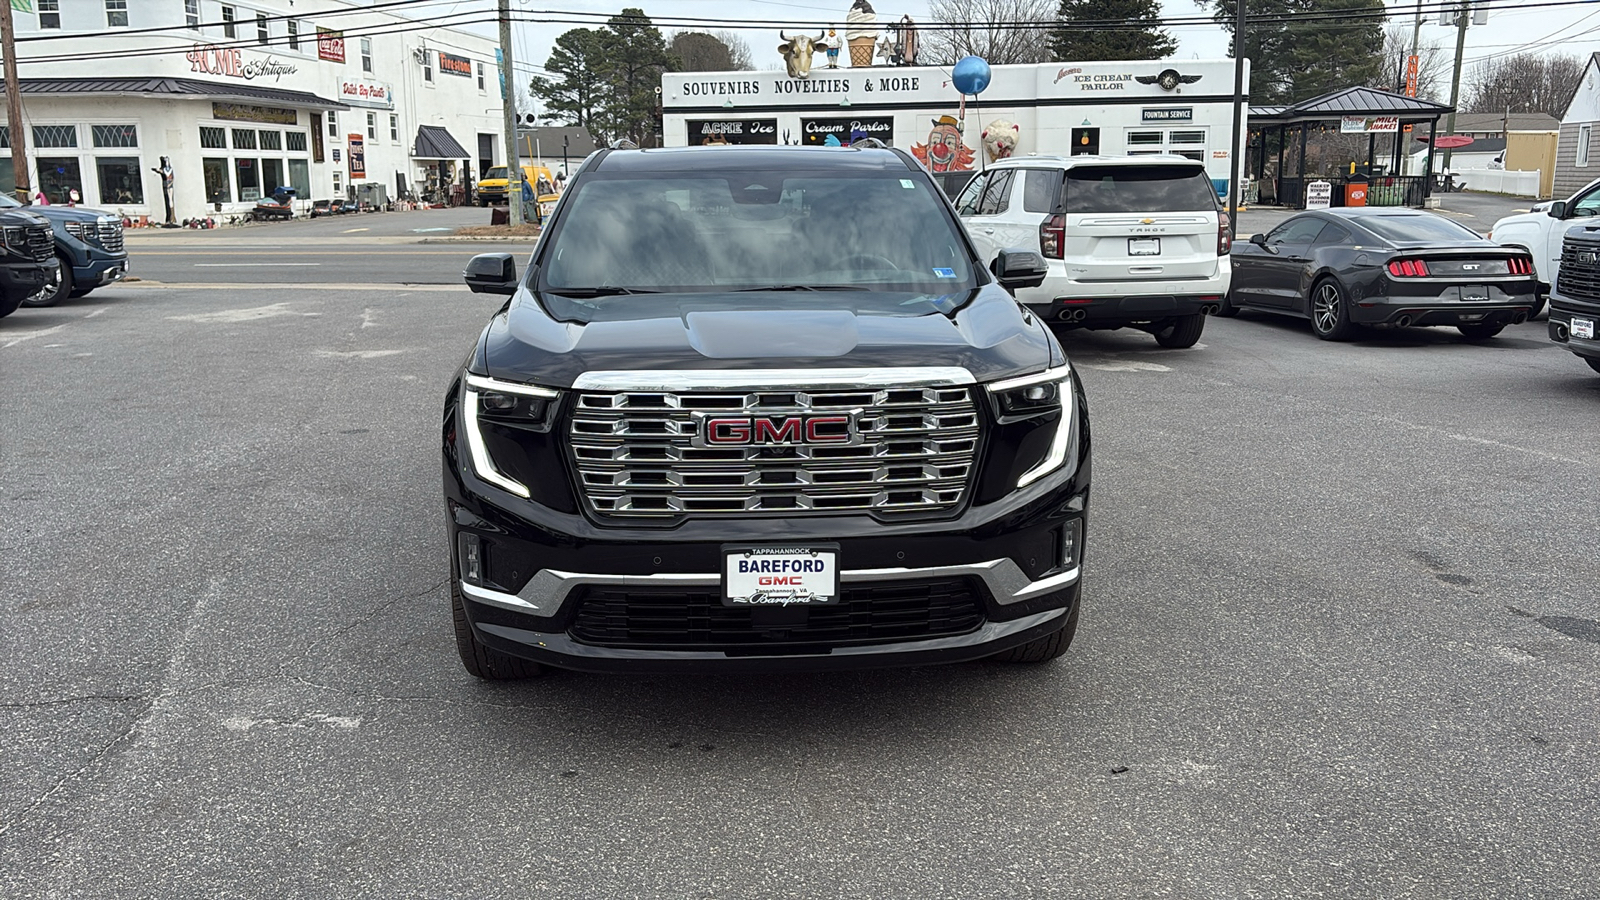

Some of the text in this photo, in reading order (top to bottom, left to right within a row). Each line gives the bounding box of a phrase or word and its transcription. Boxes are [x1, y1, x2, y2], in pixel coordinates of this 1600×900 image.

[186, 42, 243, 78] ACME
[439, 53, 471, 73] Firestone
[1093, 74, 1132, 82] CREAM
[343, 82, 385, 99] Dutch Boy Paints
[683, 77, 920, 95] SOUVENIRS NOVELTIES & MORE
[1081, 83, 1124, 91] PARLOR
[1144, 110, 1191, 119] FOUNTAIN SERVICE
[701, 122, 775, 134] ACME Ice
[805, 120, 891, 133] Cream Parlor
[1578, 252, 1600, 265] GM
[707, 416, 849, 444] GMC
[738, 559, 825, 573] BAREFORD
[758, 576, 803, 586] GMC
[749, 592, 815, 608] Bareford
